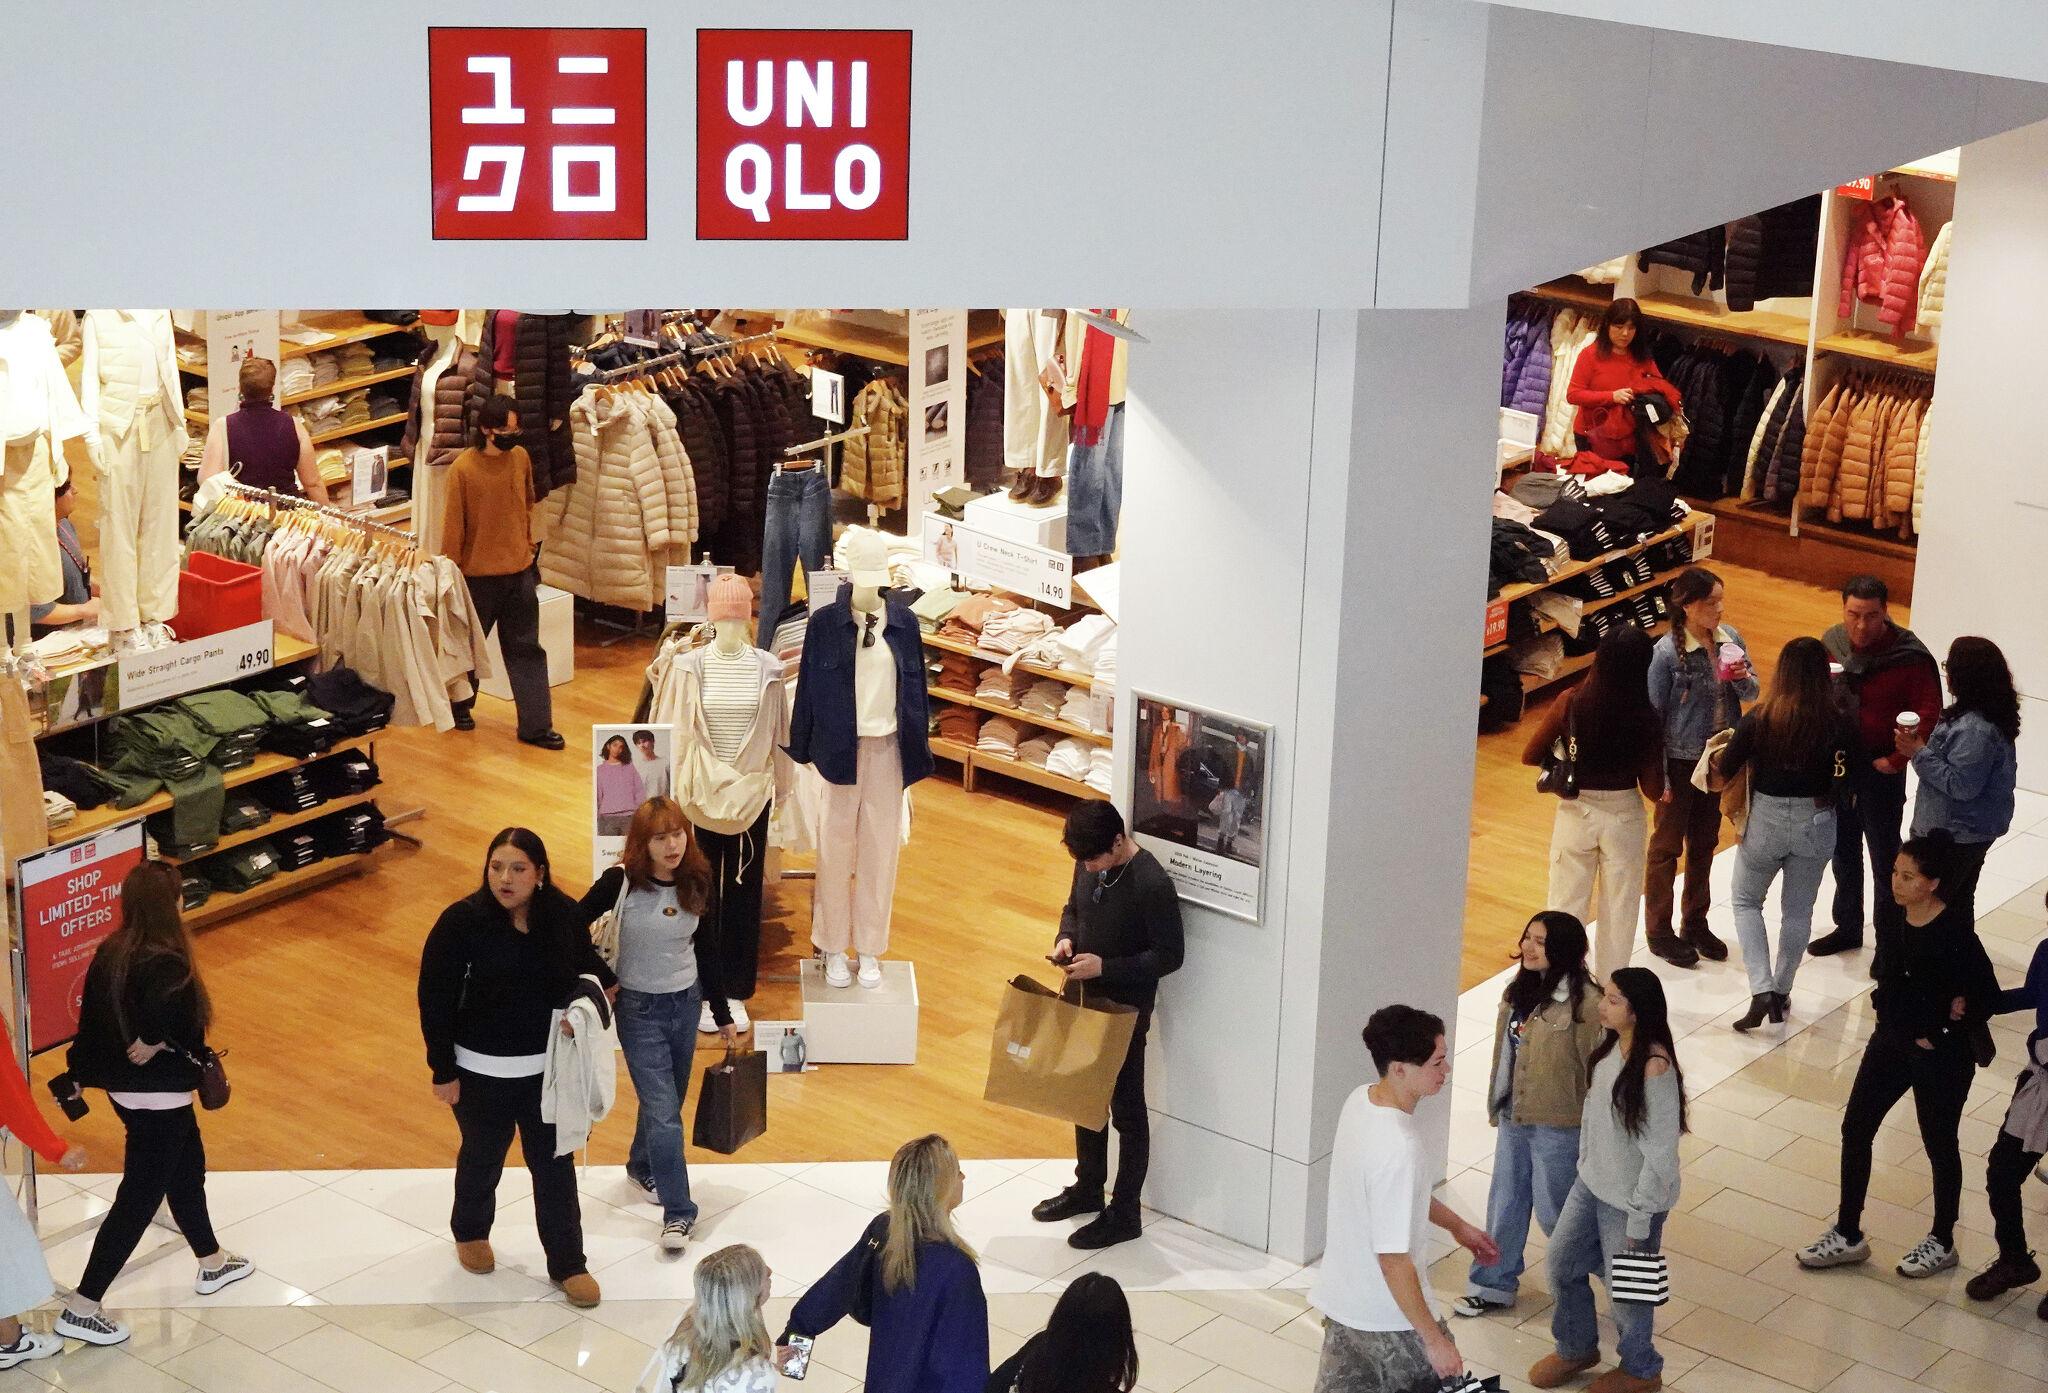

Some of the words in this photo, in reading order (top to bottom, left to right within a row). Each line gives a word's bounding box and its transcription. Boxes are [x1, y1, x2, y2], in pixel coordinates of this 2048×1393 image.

[462, 56, 615, 124] ユニ
[726, 60, 868, 128] UNI
[457, 145, 616, 212] クロ
[725, 143, 881, 223] QLO
[126, 669, 146, 681] Wide
[149, 660, 177, 675] Straight
[179, 654, 201, 666] Cargo
[203, 647, 224, 659] Pants
[67, 870, 102, 895] SHOP
[1169, 857, 1192, 871] Modern
[1194, 864, 1222, 881] Layering
[39, 881, 122, 926] LIMITED-TIM
[61, 906, 112, 938] OFFERS
